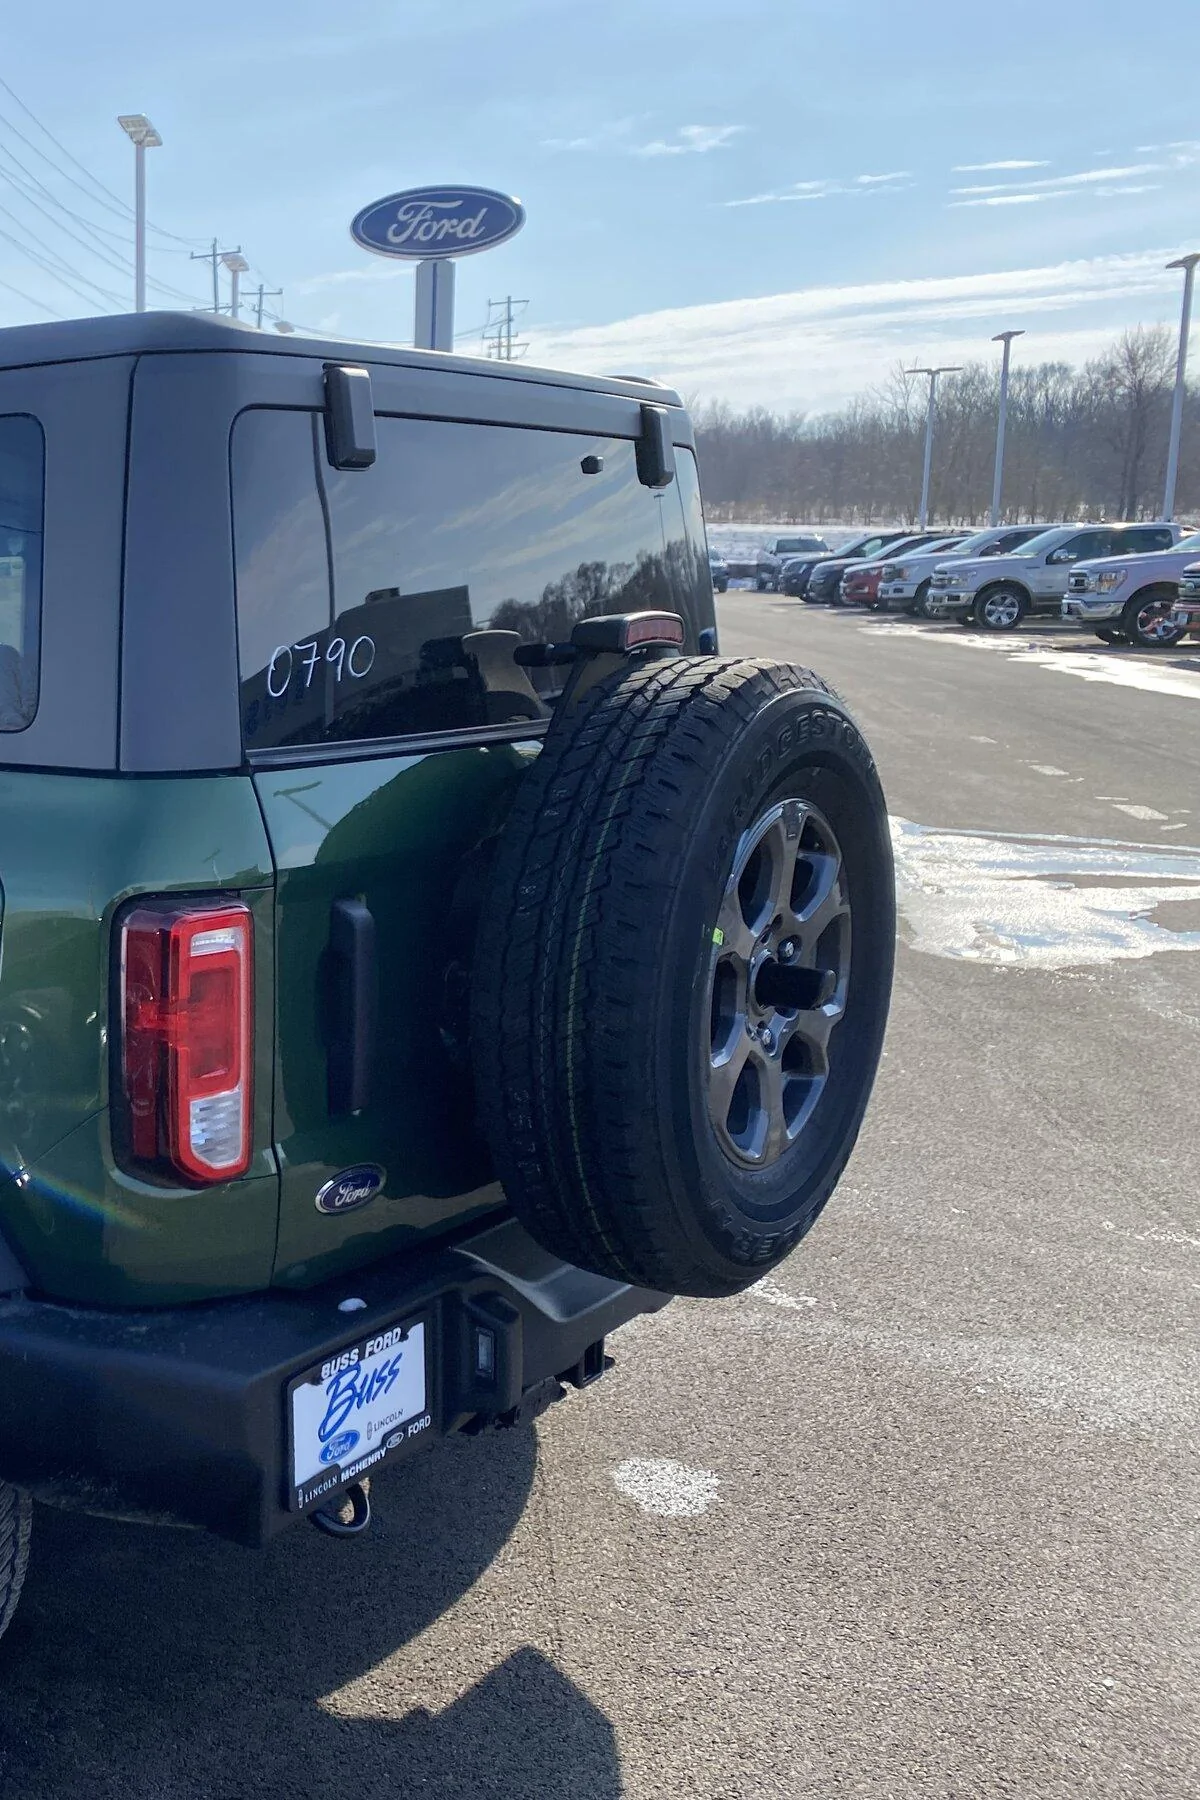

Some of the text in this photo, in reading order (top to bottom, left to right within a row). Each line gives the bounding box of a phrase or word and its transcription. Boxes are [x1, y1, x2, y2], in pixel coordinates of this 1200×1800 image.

[386, 199, 489, 243] Ford
[267, 635, 376, 697] 0790
[334, 1179, 371, 1207] Ford
[321, 1326, 402, 1380] BUSS FORD
[373, 1408, 404, 1432] LINCOLN
[304, 1475, 338, 1503] LINCOLN
[408, 1414, 432, 1438] FORD
[326, 1435, 352, 1460] Ford
